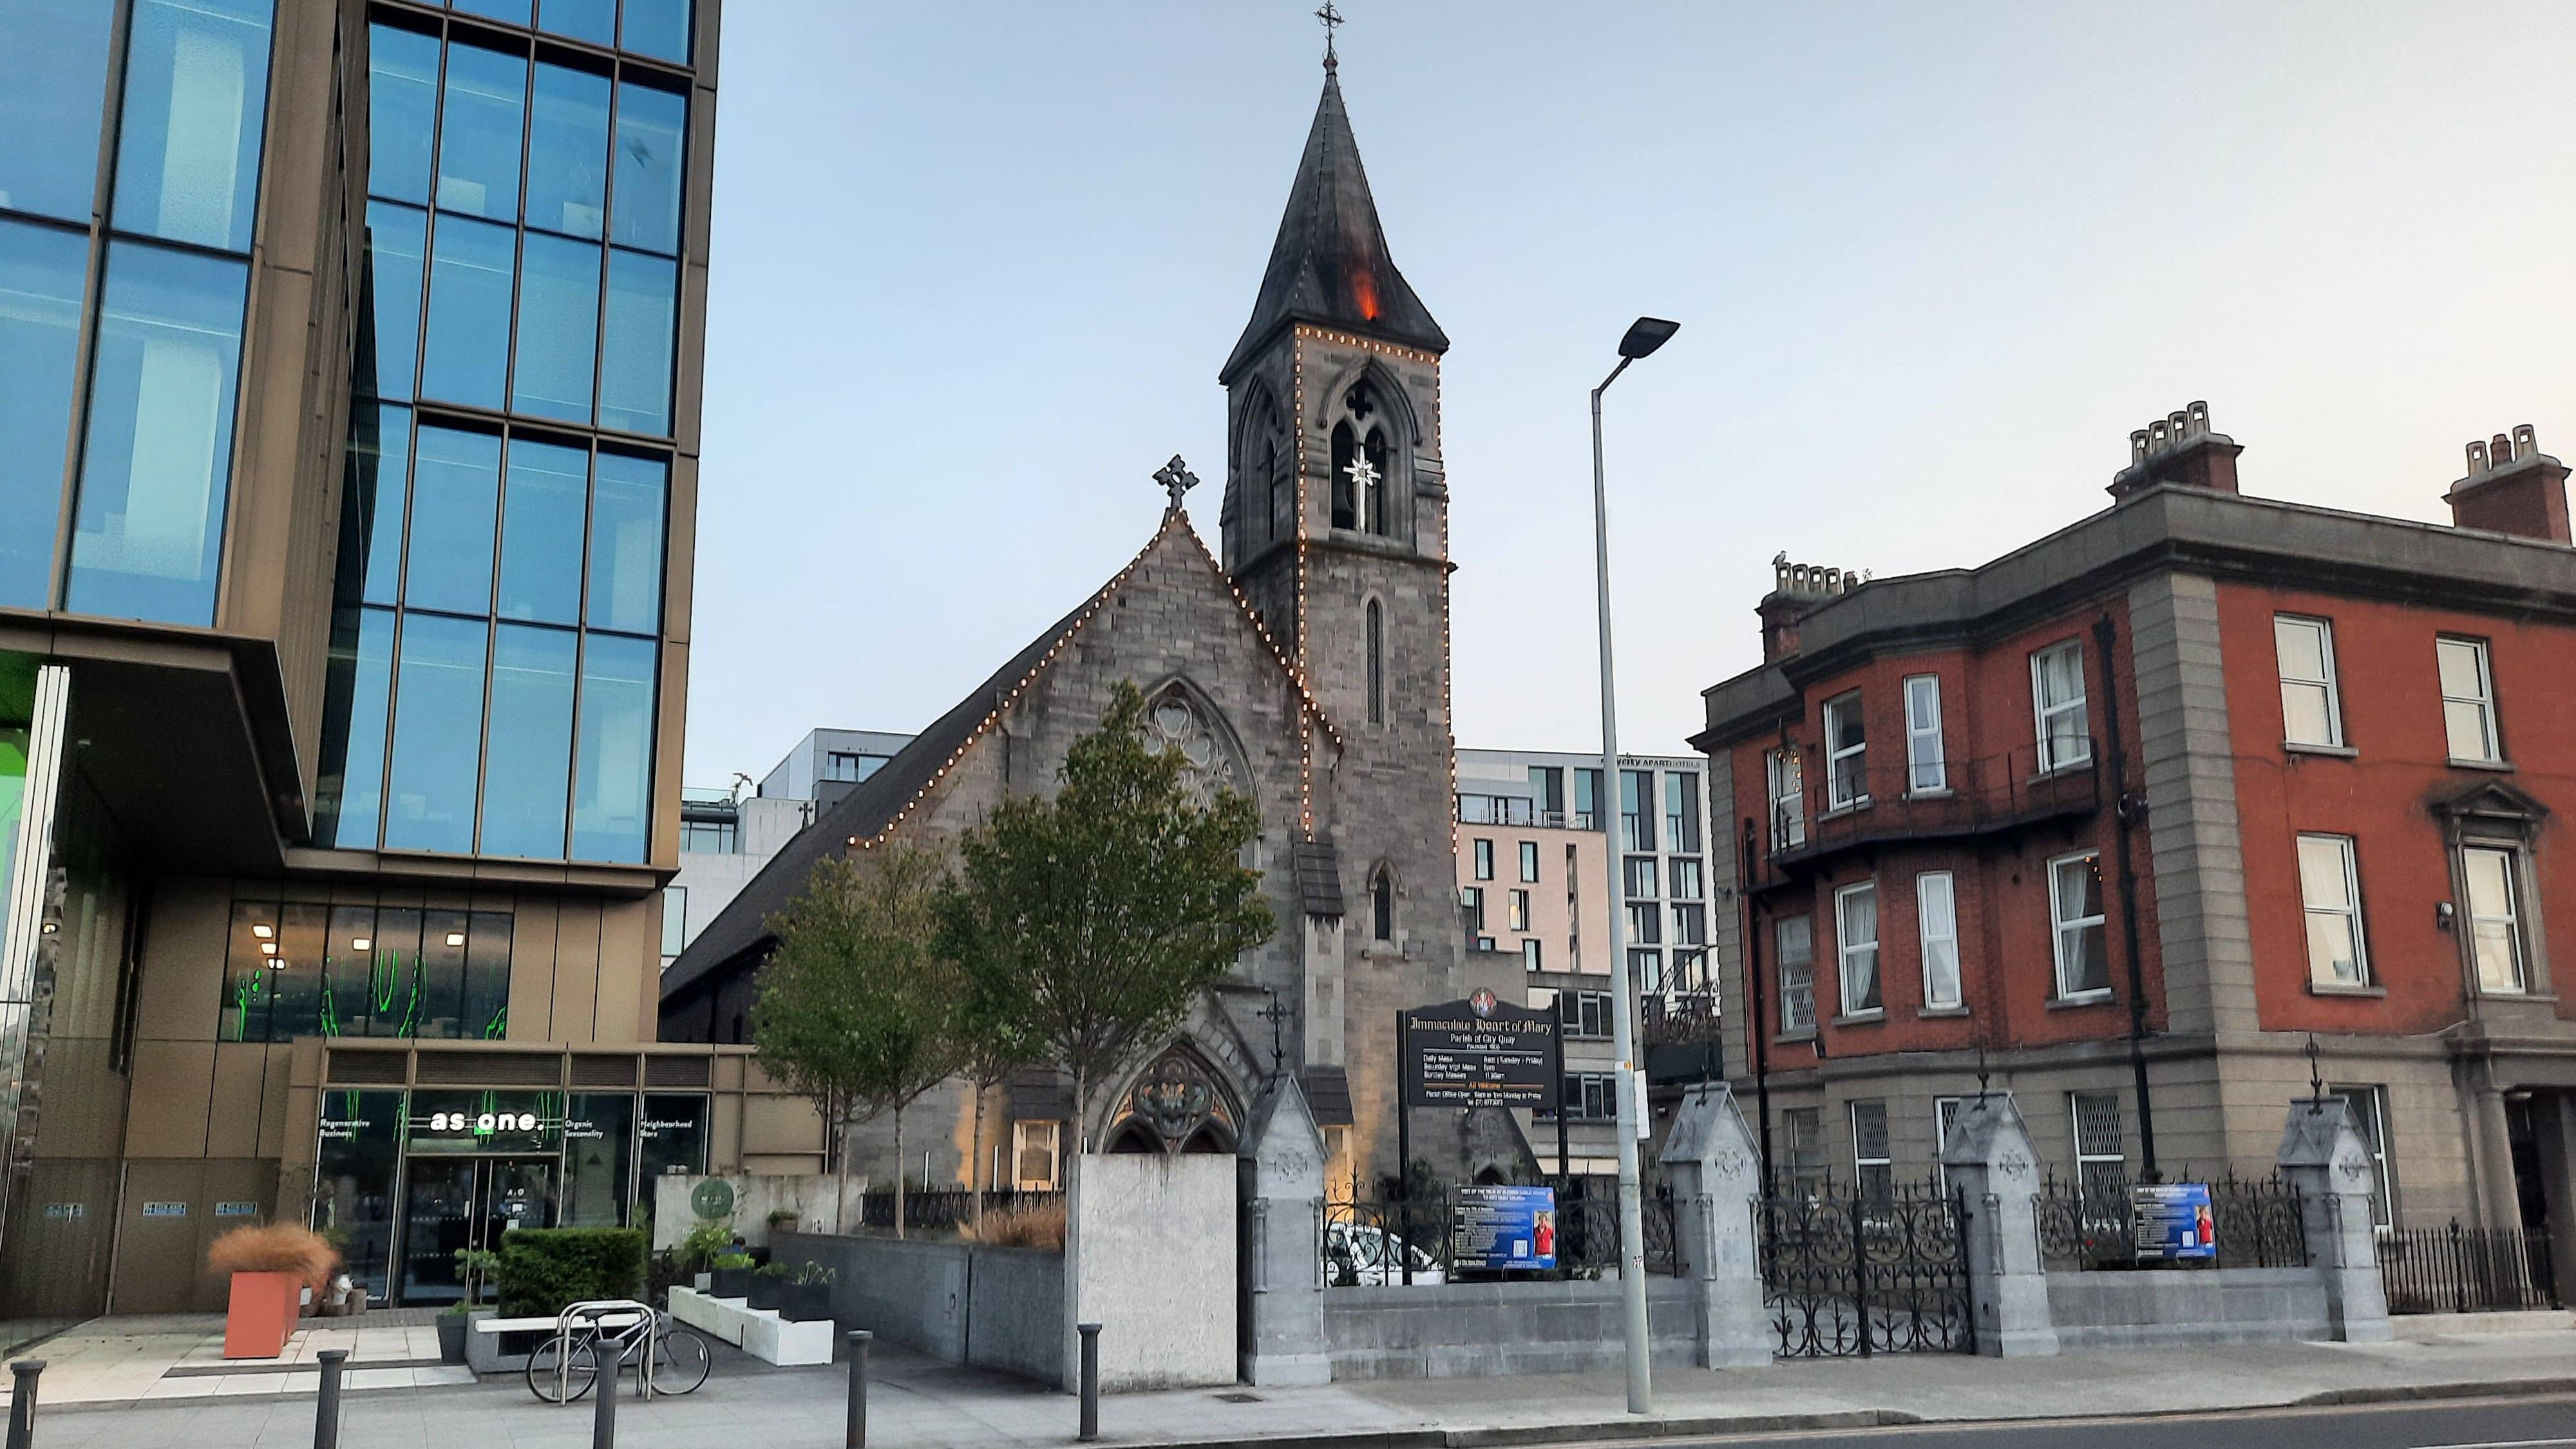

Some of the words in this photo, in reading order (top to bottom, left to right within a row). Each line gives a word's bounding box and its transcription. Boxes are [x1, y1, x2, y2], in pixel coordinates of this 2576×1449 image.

[1643, 759, 1700, 768] APARTHOTELS
[1410, 1017, 1471, 1031] Immaculate
[1475, 1018, 1510, 1033] Heart
[1511, 1019, 1521, 1032] of
[1522, 1019, 1551, 1036] Mary
[1450, 1033, 1473, 1043] Parish
[1475, 1034, 1481, 1043] of
[1483, 1034, 1497, 1045] City
[1499, 1034, 1515, 1046] Quay
[1423, 1054, 1437, 1064] Daily
[1449, 1063, 1461, 1072] Vigil
[320, 1119, 370, 1130] Regenerative
[430, 1113, 465, 1131] as
[477, 1113, 544, 1131] one.
[564, 1120, 592, 1130] Organic
[640, 1120, 692, 1130] Neighbourhood
[564, 1130, 604, 1140] Seasonality
[639, 1130, 658, 1138] Store
